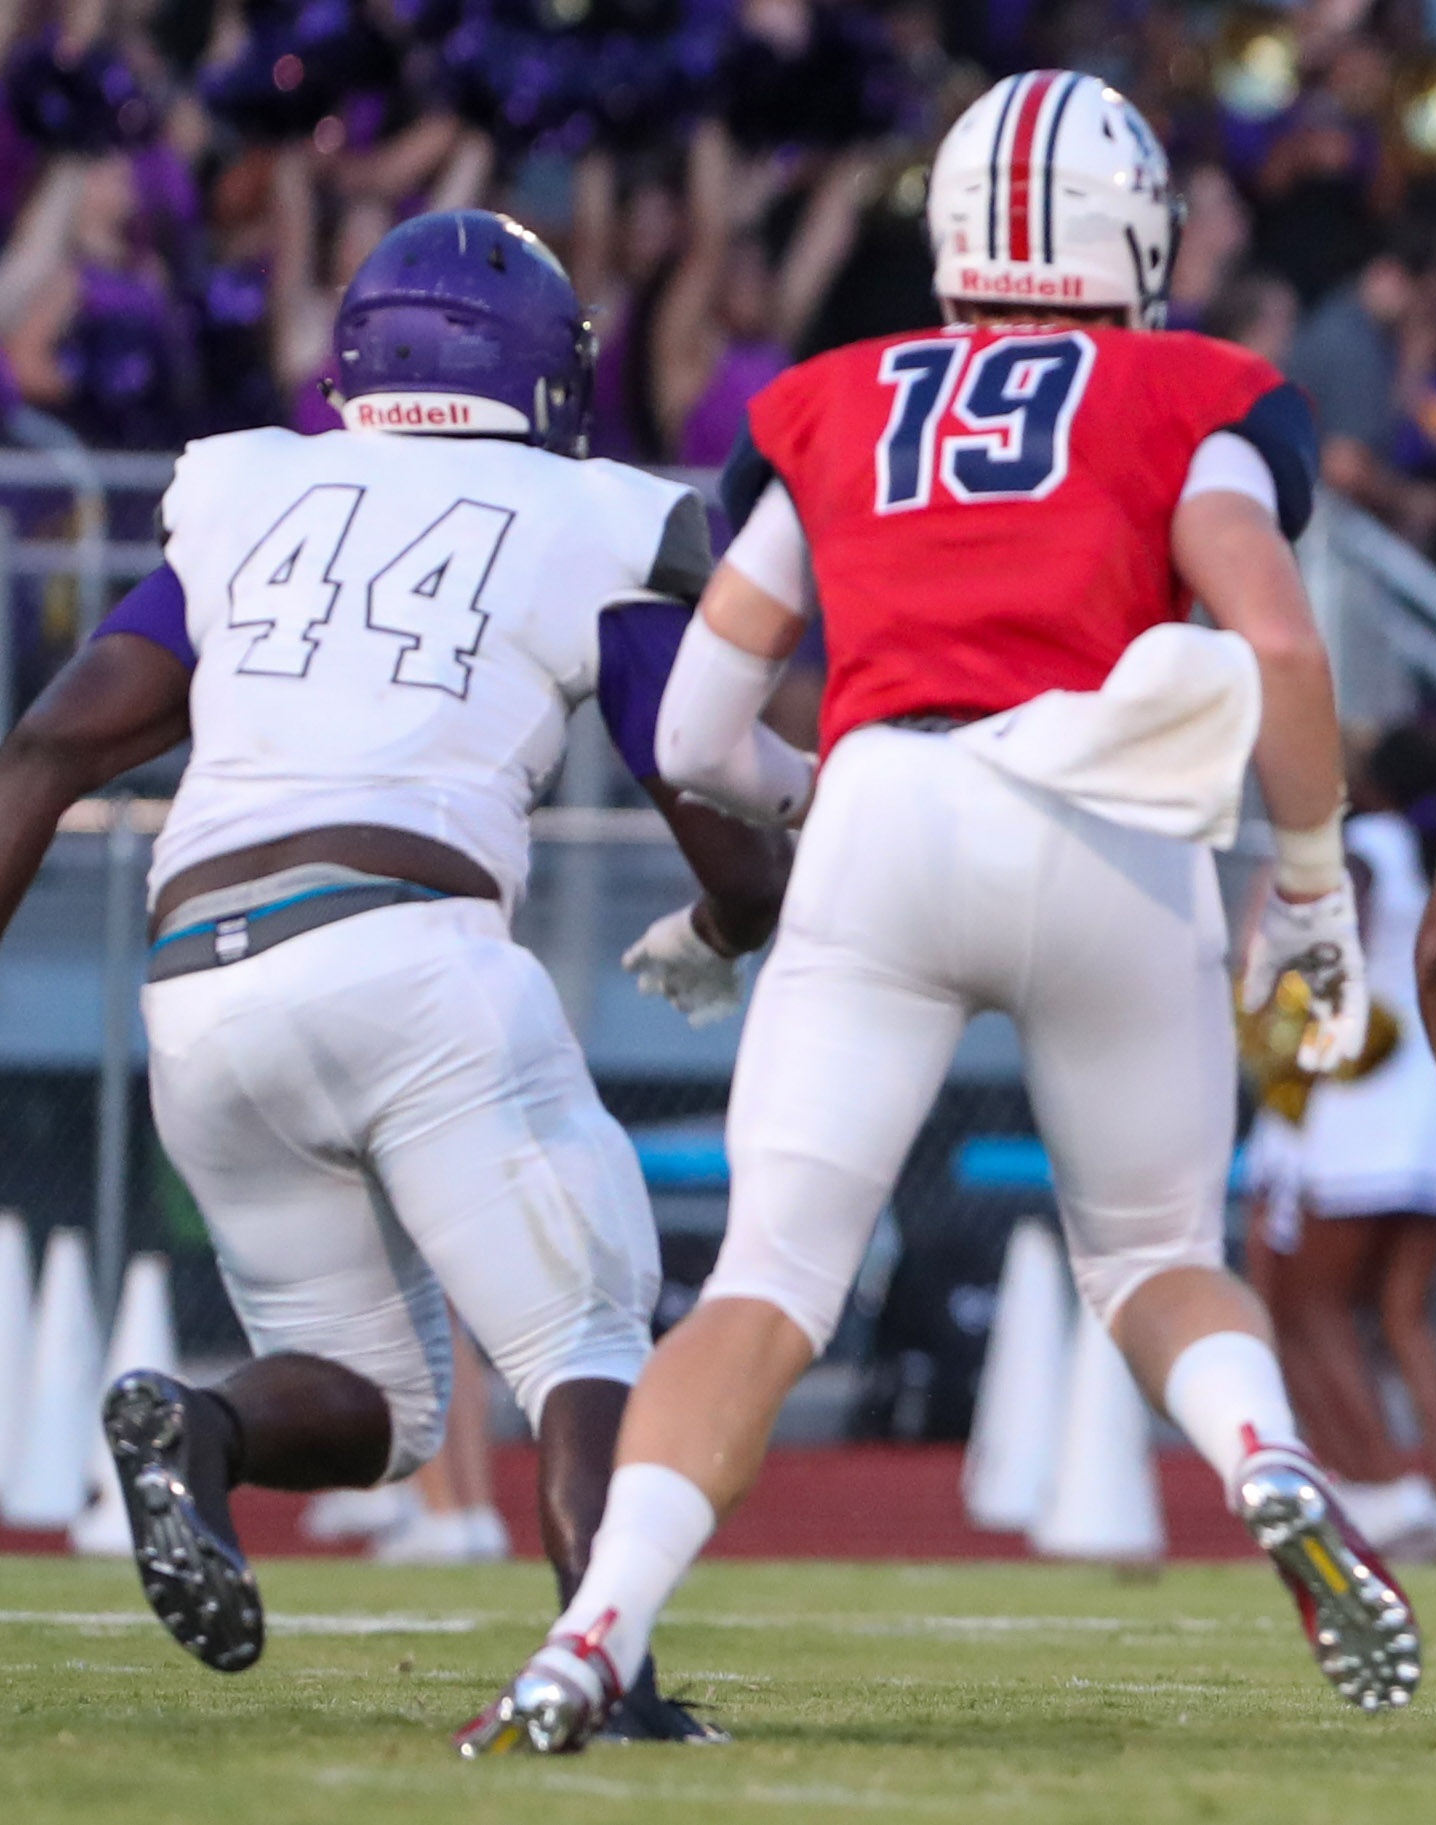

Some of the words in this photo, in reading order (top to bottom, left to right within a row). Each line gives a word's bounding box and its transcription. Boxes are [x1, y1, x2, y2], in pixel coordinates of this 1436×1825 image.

[961, 268, 1084, 297] Riddell
[358, 403, 469, 426] Riddell
[873, 329, 1098, 516] 19
[228, 482, 518, 702] 44
